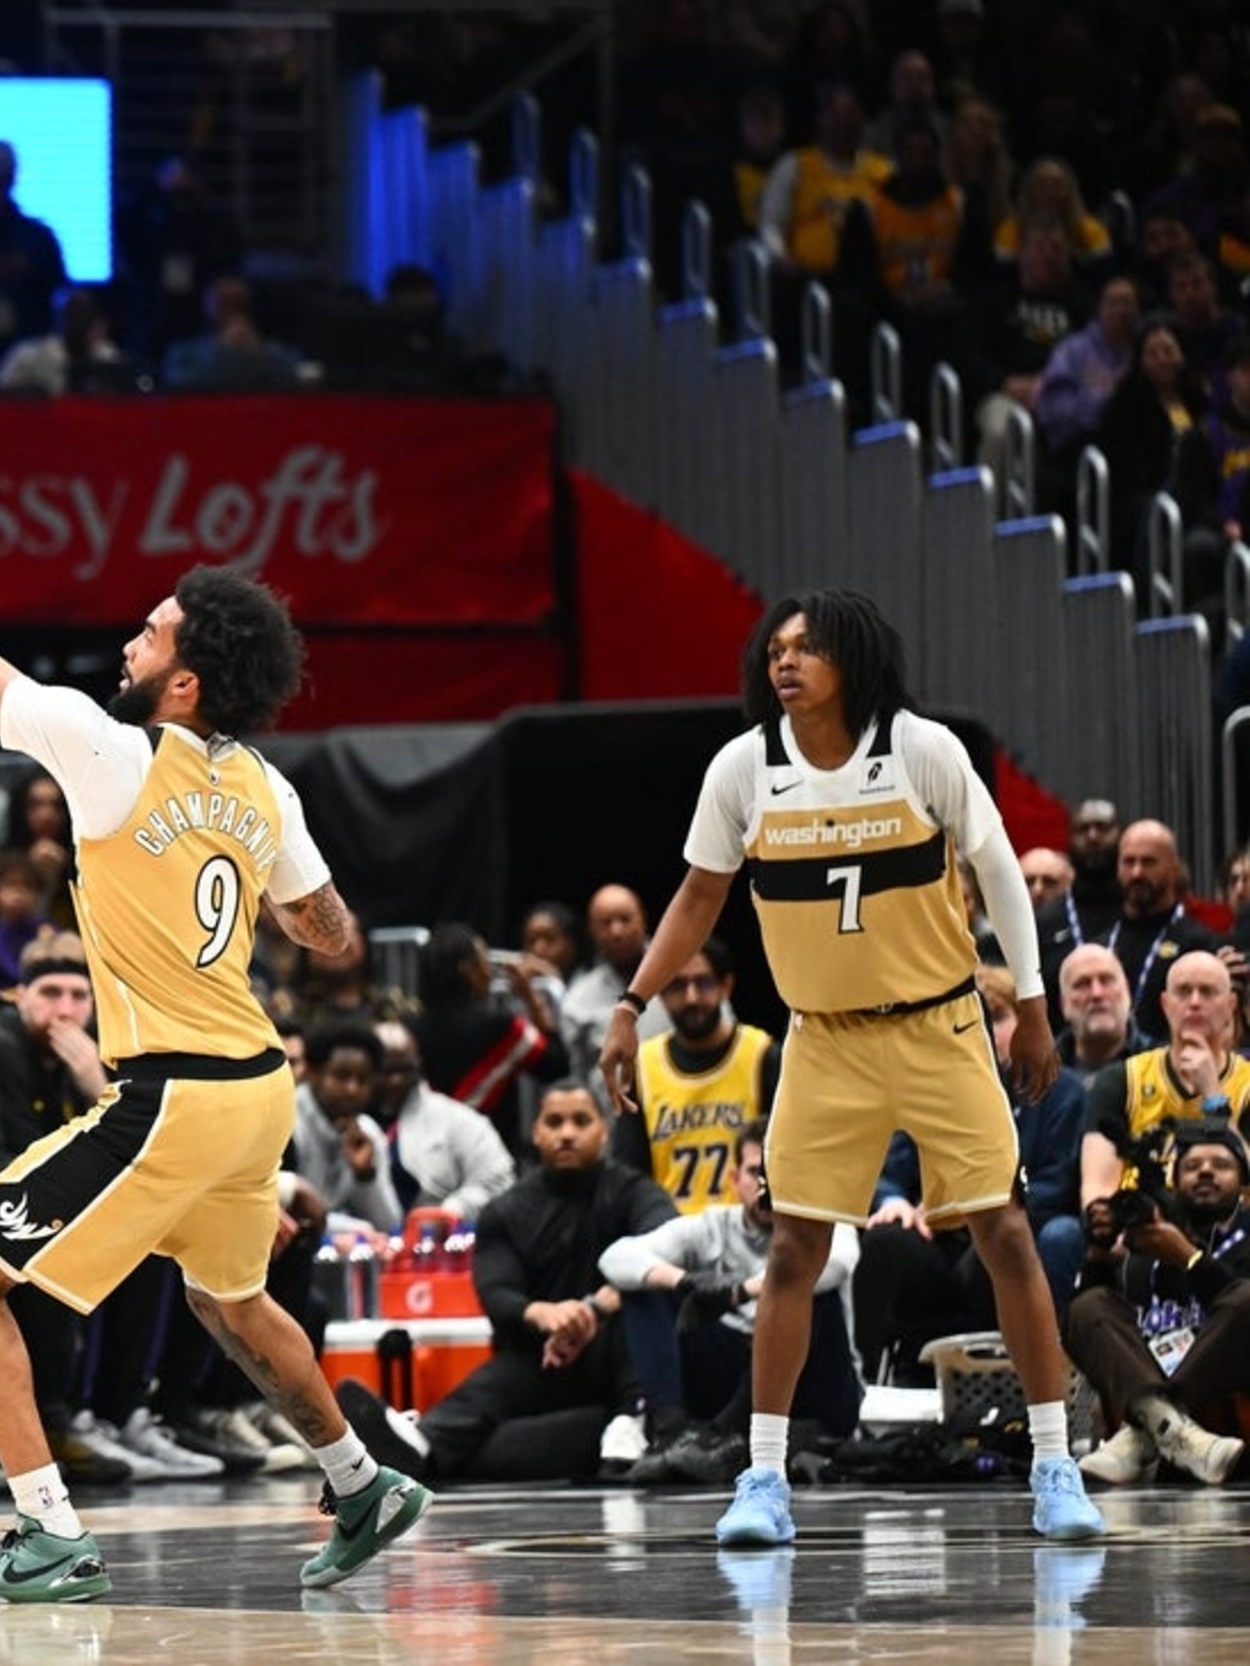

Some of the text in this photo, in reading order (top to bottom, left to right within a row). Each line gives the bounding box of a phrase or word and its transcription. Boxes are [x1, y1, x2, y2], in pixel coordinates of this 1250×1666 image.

[138, 443, 382, 574] Lofts
[764, 816, 902, 848] washington
[194, 854, 241, 969] 9
[826, 865, 865, 935] 7
[653, 1102, 744, 1143] LAKERS
[673, 1143, 729, 1198] 77
